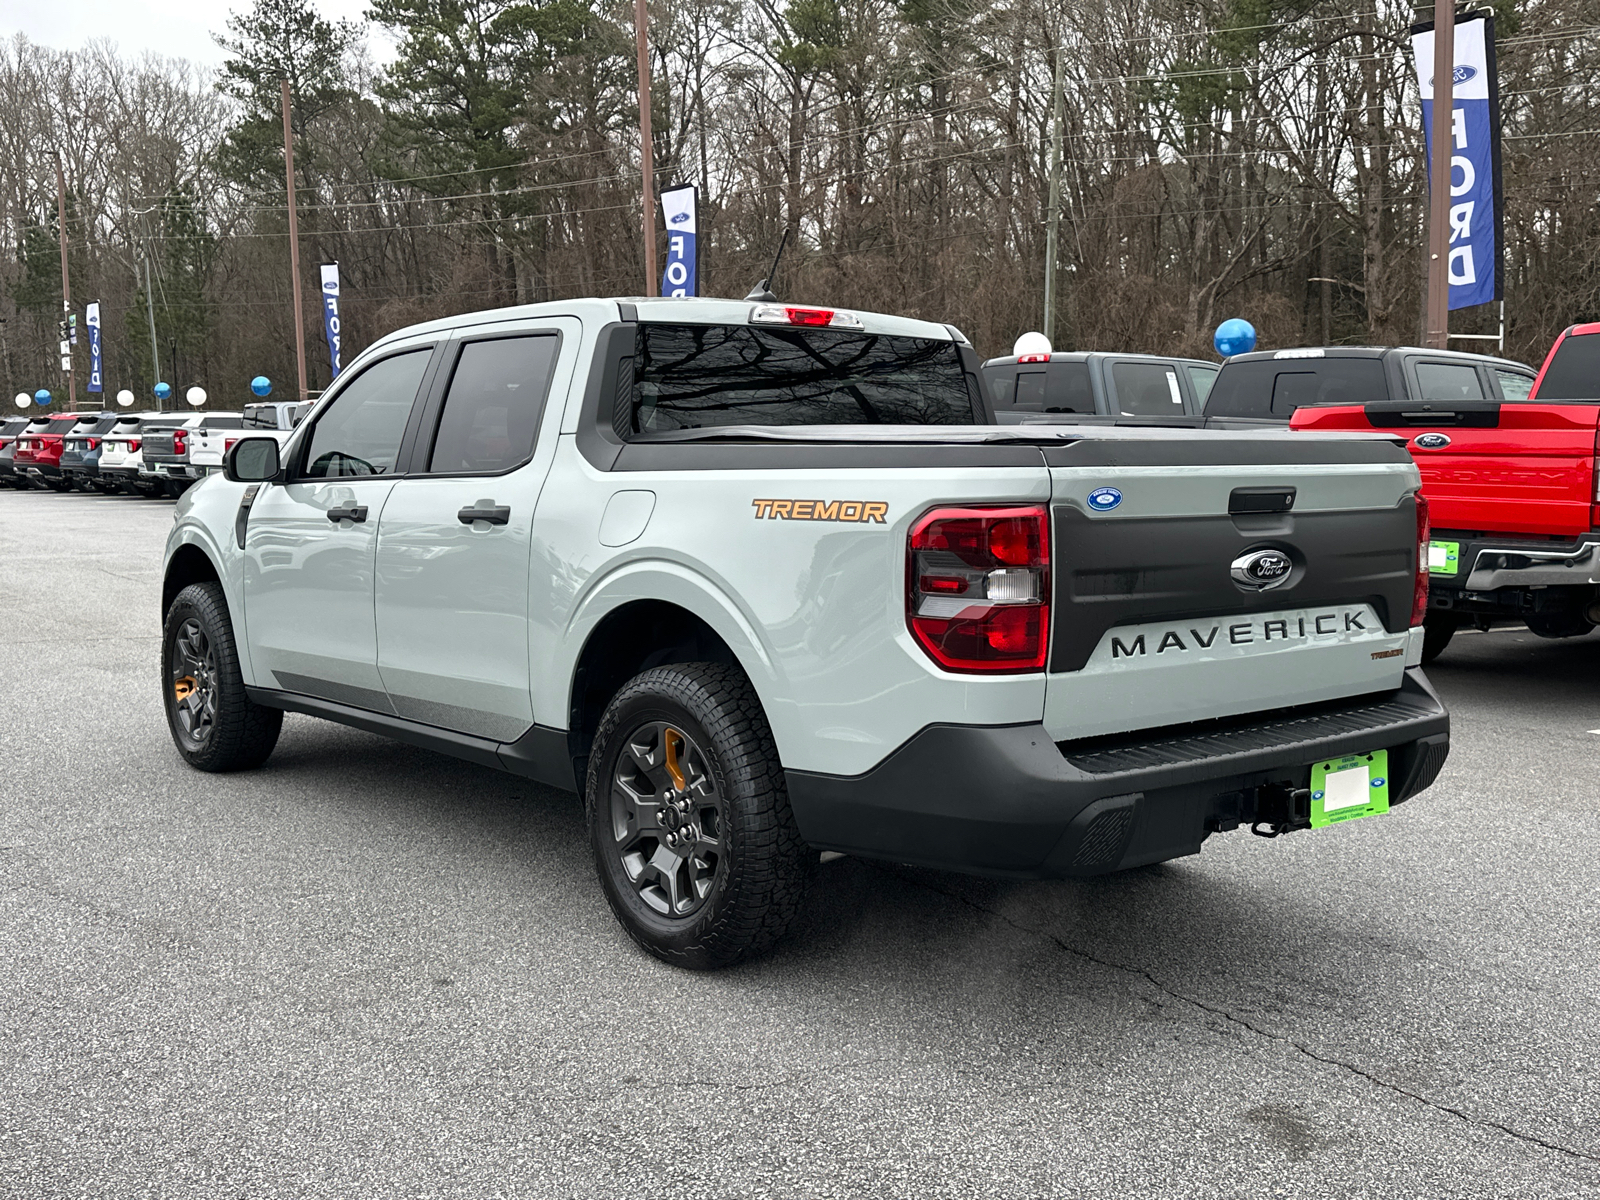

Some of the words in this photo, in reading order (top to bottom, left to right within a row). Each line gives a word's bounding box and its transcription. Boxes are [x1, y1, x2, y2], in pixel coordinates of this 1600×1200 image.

[752, 498, 889, 524] TREMOR
[1257, 557, 1284, 577] Ford
[1111, 610, 1367, 660] MAVERICK
